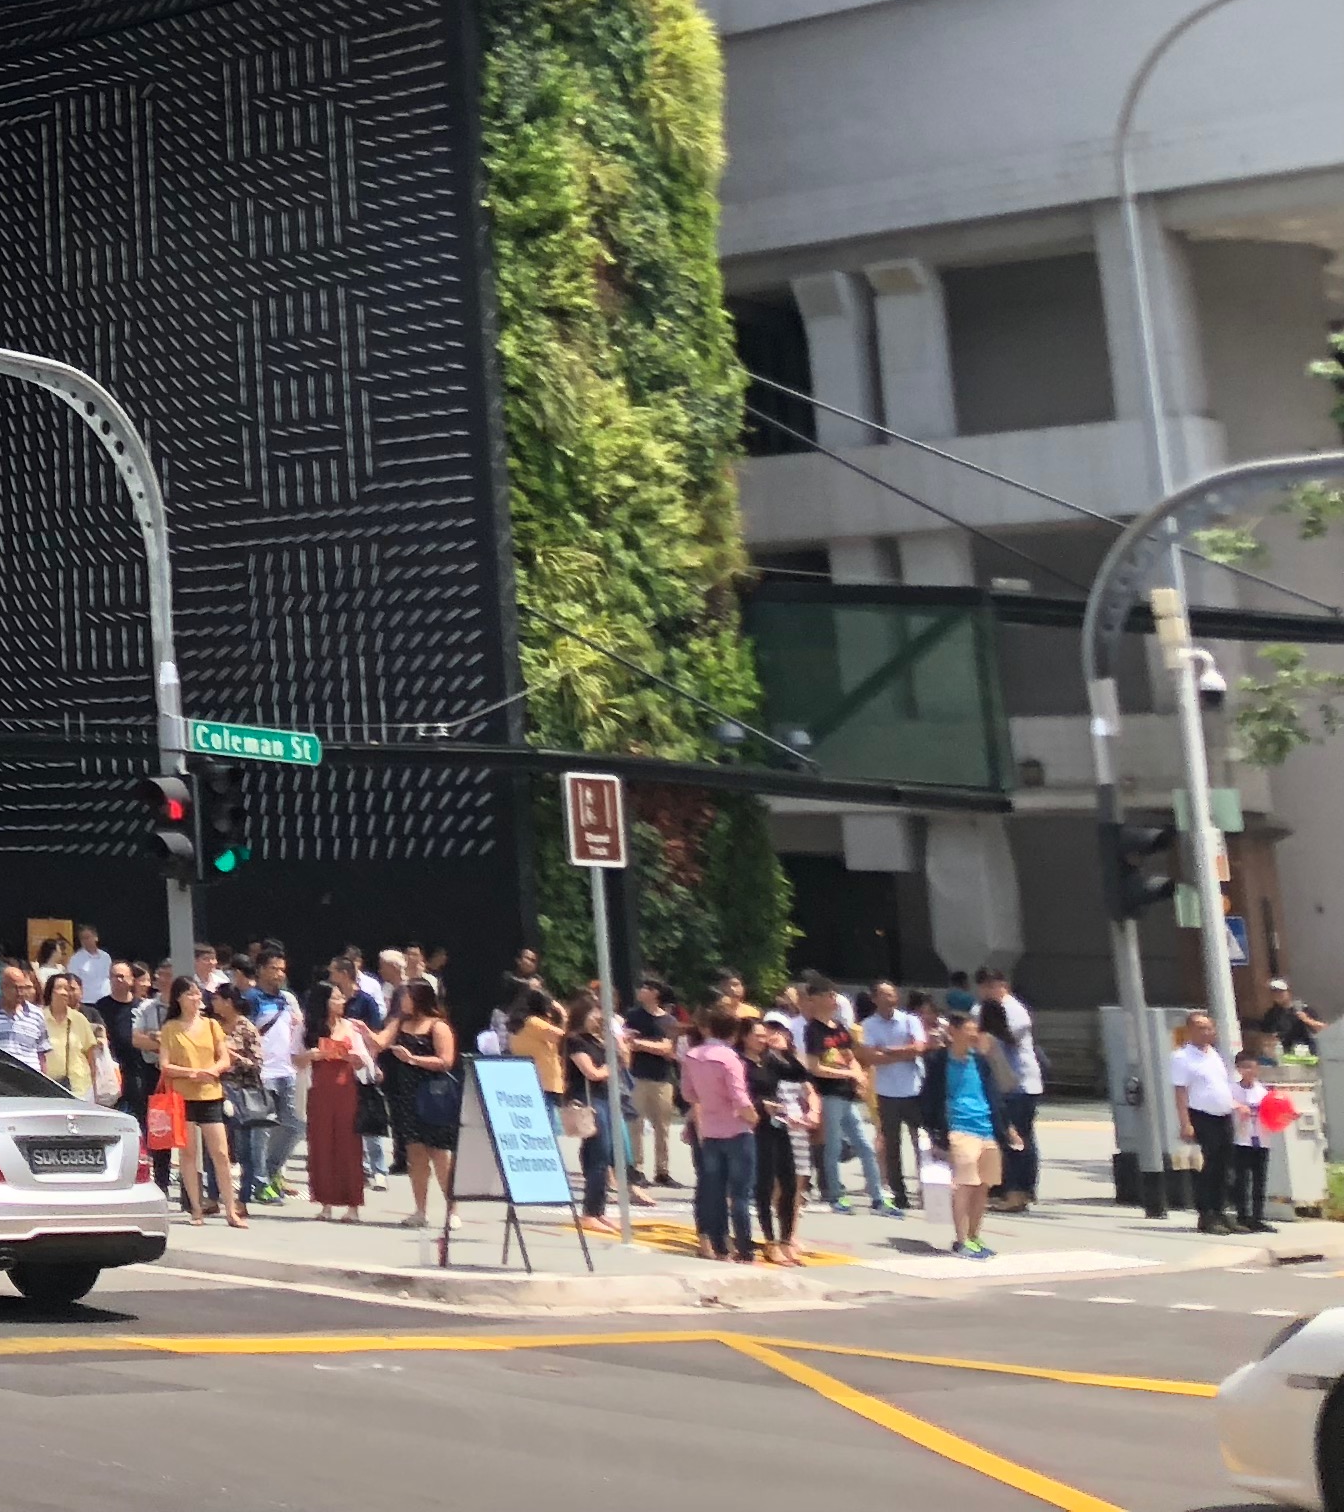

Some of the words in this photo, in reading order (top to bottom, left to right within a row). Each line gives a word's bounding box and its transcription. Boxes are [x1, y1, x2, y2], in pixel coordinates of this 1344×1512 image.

[196, 724, 284, 757] Coleman
[291, 736, 312, 761] St
[495, 1090, 534, 1109] Please
[507, 1112, 533, 1130] Use
[498, 1133, 518, 1151] Hill
[519, 1133, 555, 1151] Street
[507, 1154, 558, 1173] Entrance
